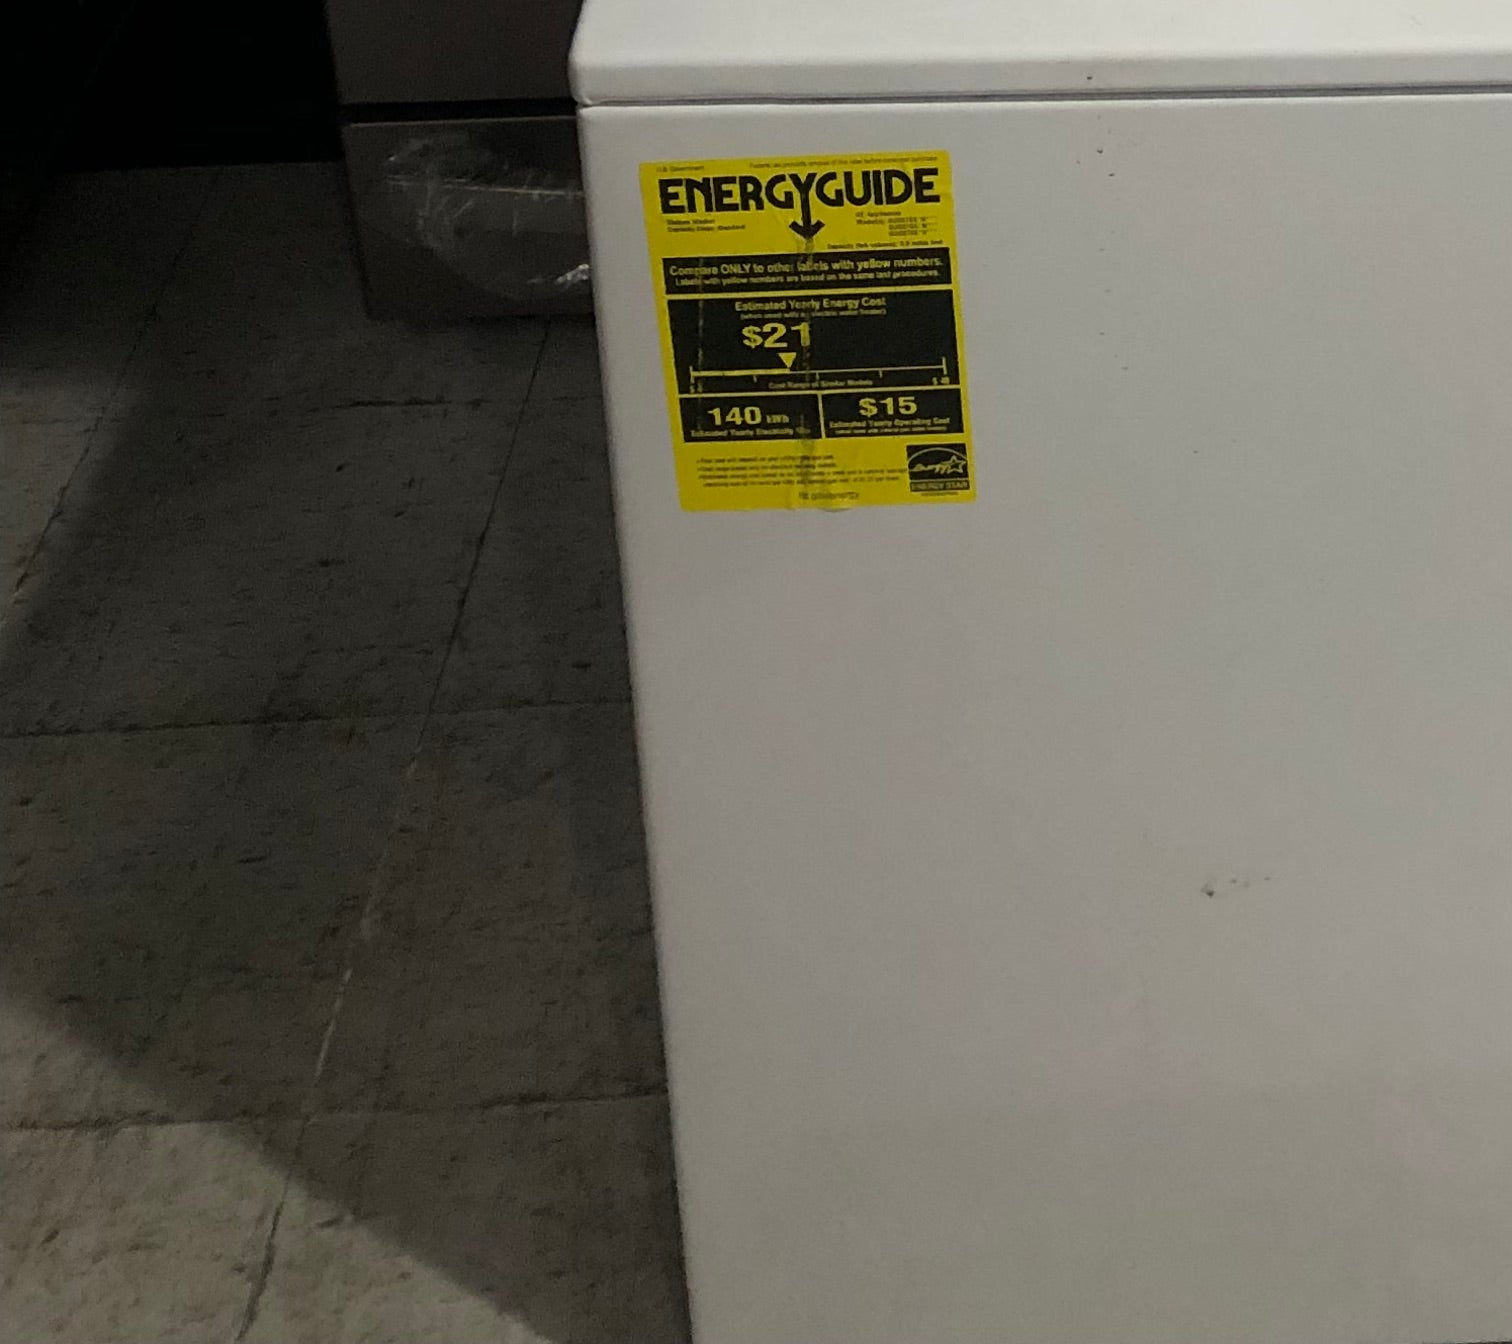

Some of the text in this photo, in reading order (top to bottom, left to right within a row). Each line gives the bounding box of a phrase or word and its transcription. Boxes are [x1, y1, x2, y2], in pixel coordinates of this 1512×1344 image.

[658, 167, 941, 214] ENERGYGUIDE
[670, 265, 719, 275] Compare
[720, 263, 751, 274] ONLY
[752, 263, 764, 273] to
[831, 260, 855, 270] with
[856, 258, 891, 271] yellow
[735, 296, 887, 311] Estimated Yearly Energy Cost
[742, 322, 811, 349] $21
[707, 406, 762, 426] 140
[859, 396, 918, 418] $15
